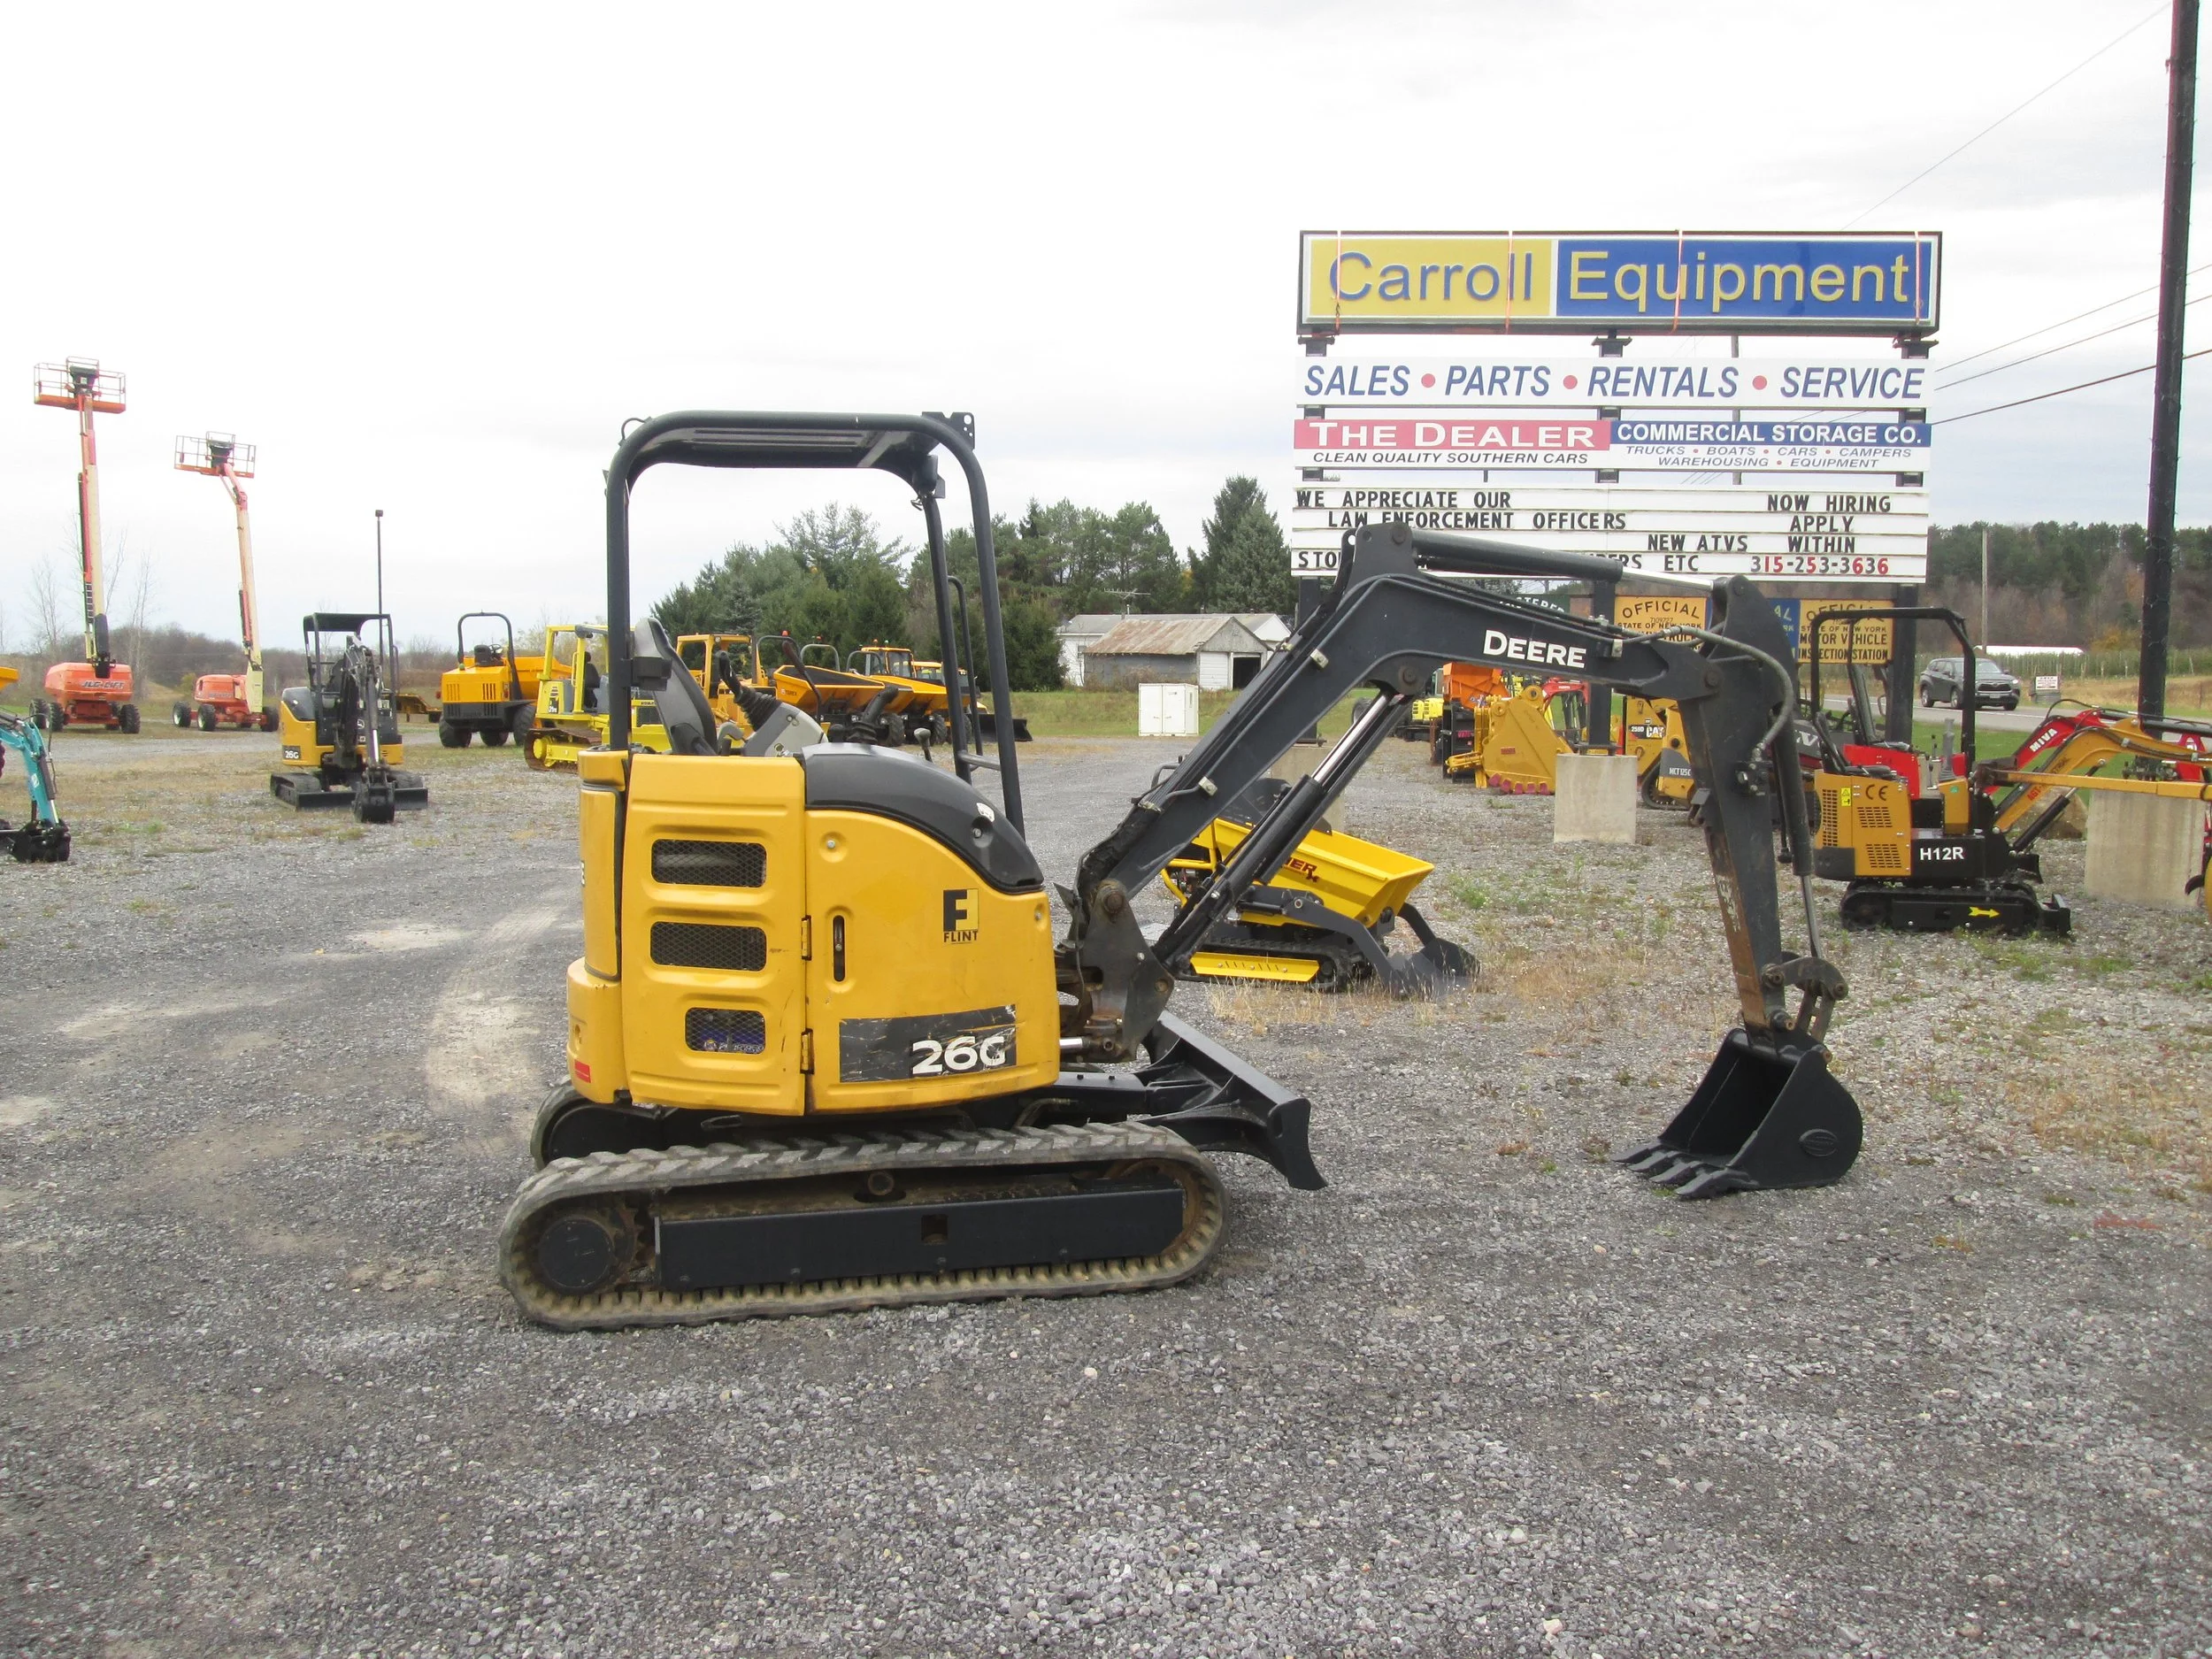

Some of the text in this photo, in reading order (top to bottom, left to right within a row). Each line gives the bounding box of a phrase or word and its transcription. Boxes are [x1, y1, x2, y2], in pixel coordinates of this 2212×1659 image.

[1330, 250, 1909, 313] Carroll Equipment
[1304, 365, 1926, 398] SALES PARTS RENTALS SERVICE
[1310, 422, 1595, 448] THE DEALER
[1617, 424, 1923, 443] COMMERCIAL STORAGE CO.
[1313, 452, 1588, 464] CLEAN QUALITY SOUTHERN CARS
[1626, 445, 1912, 457] TRUCKS BOATS CARS CAMPERS
[1658, 457, 1879, 468] WAREHOUSING EQUIPMENT
[1296, 490, 1511, 508] WE APPRECIATE OUR
[1768, 494, 1891, 512] NOW HIRING
[1328, 511, 1626, 529] LAW ENFORCEMENT OFFICERS
[1789, 515, 1855, 533] APPLY
[1647, 534, 1748, 552] NEW ATVS
[1787, 535, 1855, 553] WITHIN
[1298, 550, 1341, 568] STO
[1664, 555, 1889, 574] ETC 315-253-3636
[1622, 600, 1700, 618] OFFICIAL
[1841, 634, 1888, 645] VHICLE
[1483, 629, 1586, 669] DEERE
[1852, 649, 1889, 660] STATION
[2029, 728, 2058, 752] MIVA
[284, 750, 299, 759] 26G
[1919, 846, 1964, 861] H12R
[943, 930, 979, 943] FLINT
[912, 1035, 1006, 1074] 26G
